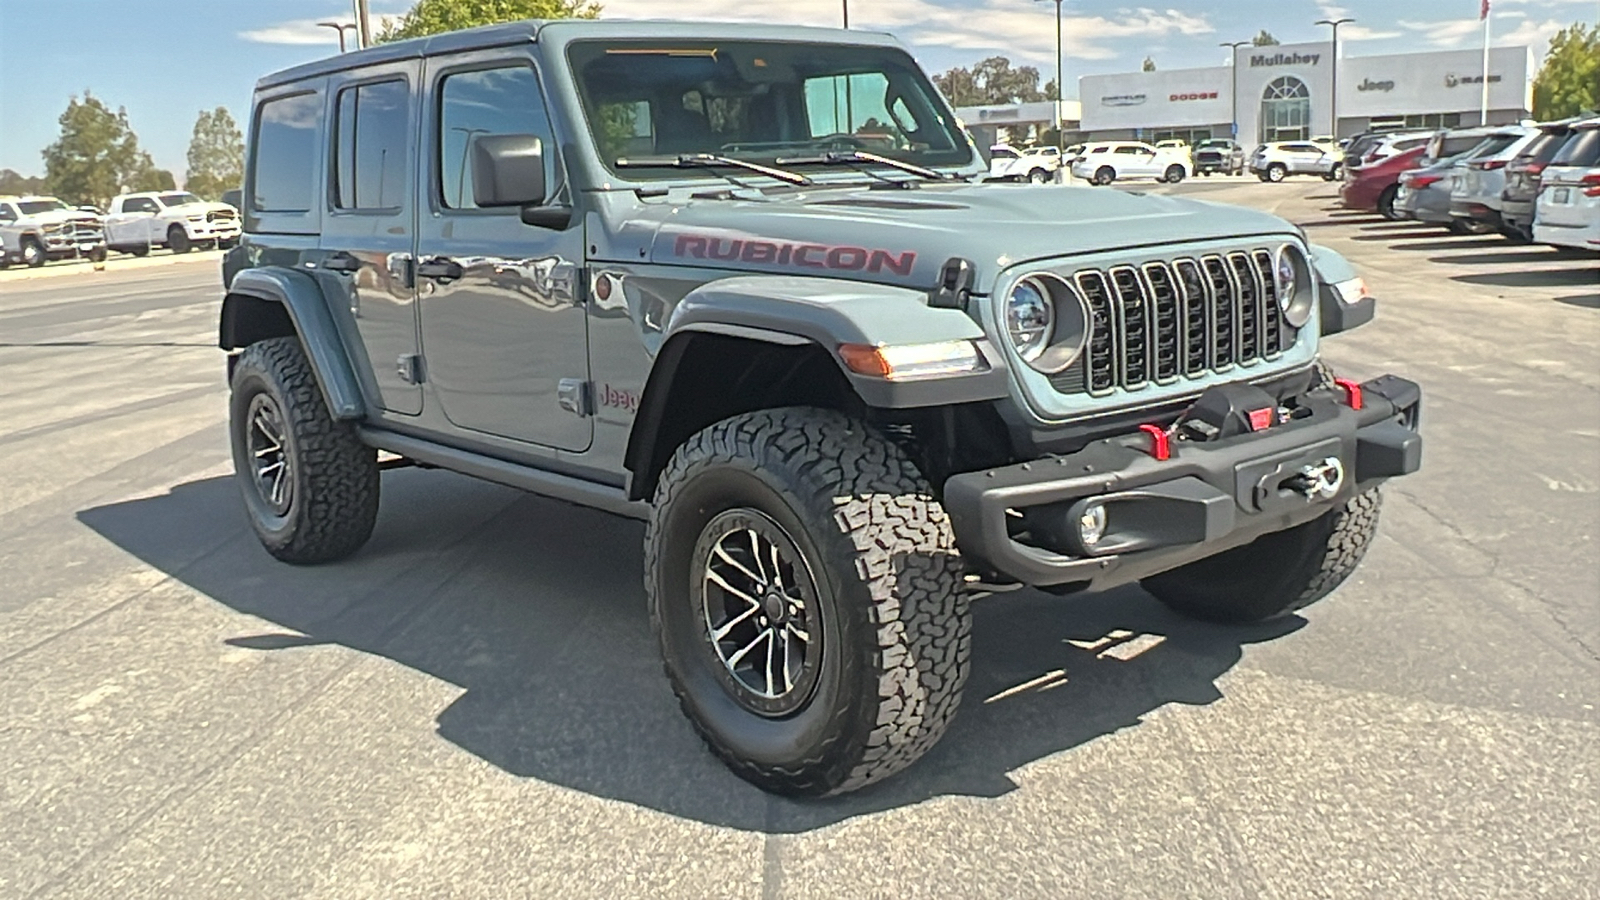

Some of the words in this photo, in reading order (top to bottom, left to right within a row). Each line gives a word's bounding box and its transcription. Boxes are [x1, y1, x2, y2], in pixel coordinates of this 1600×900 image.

[1250, 52, 1320, 67] Mullahey
[1357, 78, 1395, 92] Jeep
[1169, 92, 1218, 102] DODGE
[674, 233, 917, 276] RUBICON
